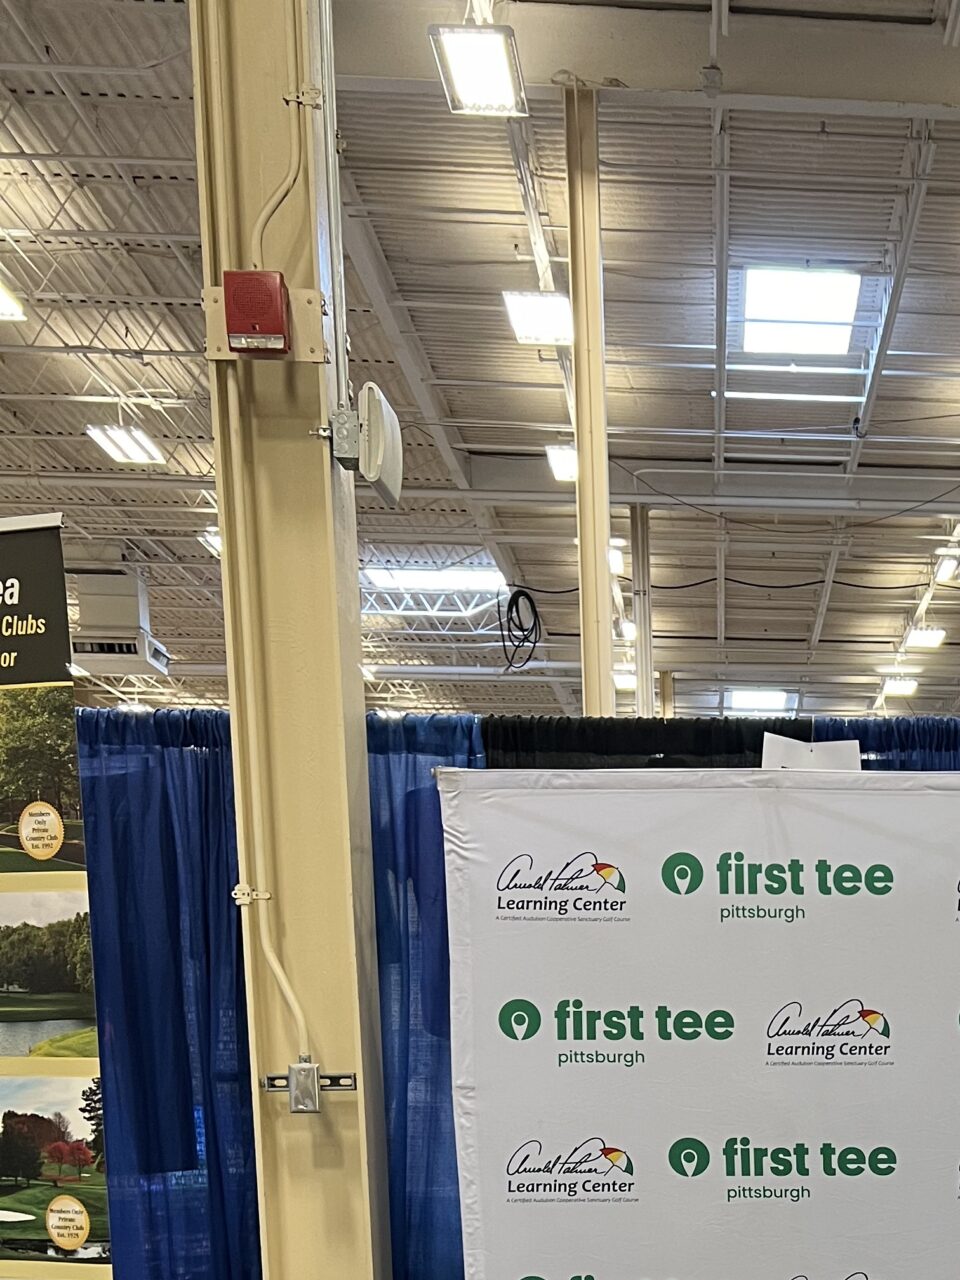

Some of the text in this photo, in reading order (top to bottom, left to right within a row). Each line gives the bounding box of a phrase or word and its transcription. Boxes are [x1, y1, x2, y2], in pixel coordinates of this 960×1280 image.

[1, 614, 46, 636] Clubs
[716, 852, 894, 896] first tee
[497, 896, 626, 915] Learning Center
[721, 905, 805, 923] pittsburgh
[554, 999, 734, 1040] first tee
[558, 1050, 645, 1067] pittsburgh
[767, 1042, 891, 1060] Learning Center
[723, 1137, 897, 1176] first tee
[508, 1179, 635, 1197] Learning Center
[727, 1186, 810, 1202] pittsburgh
